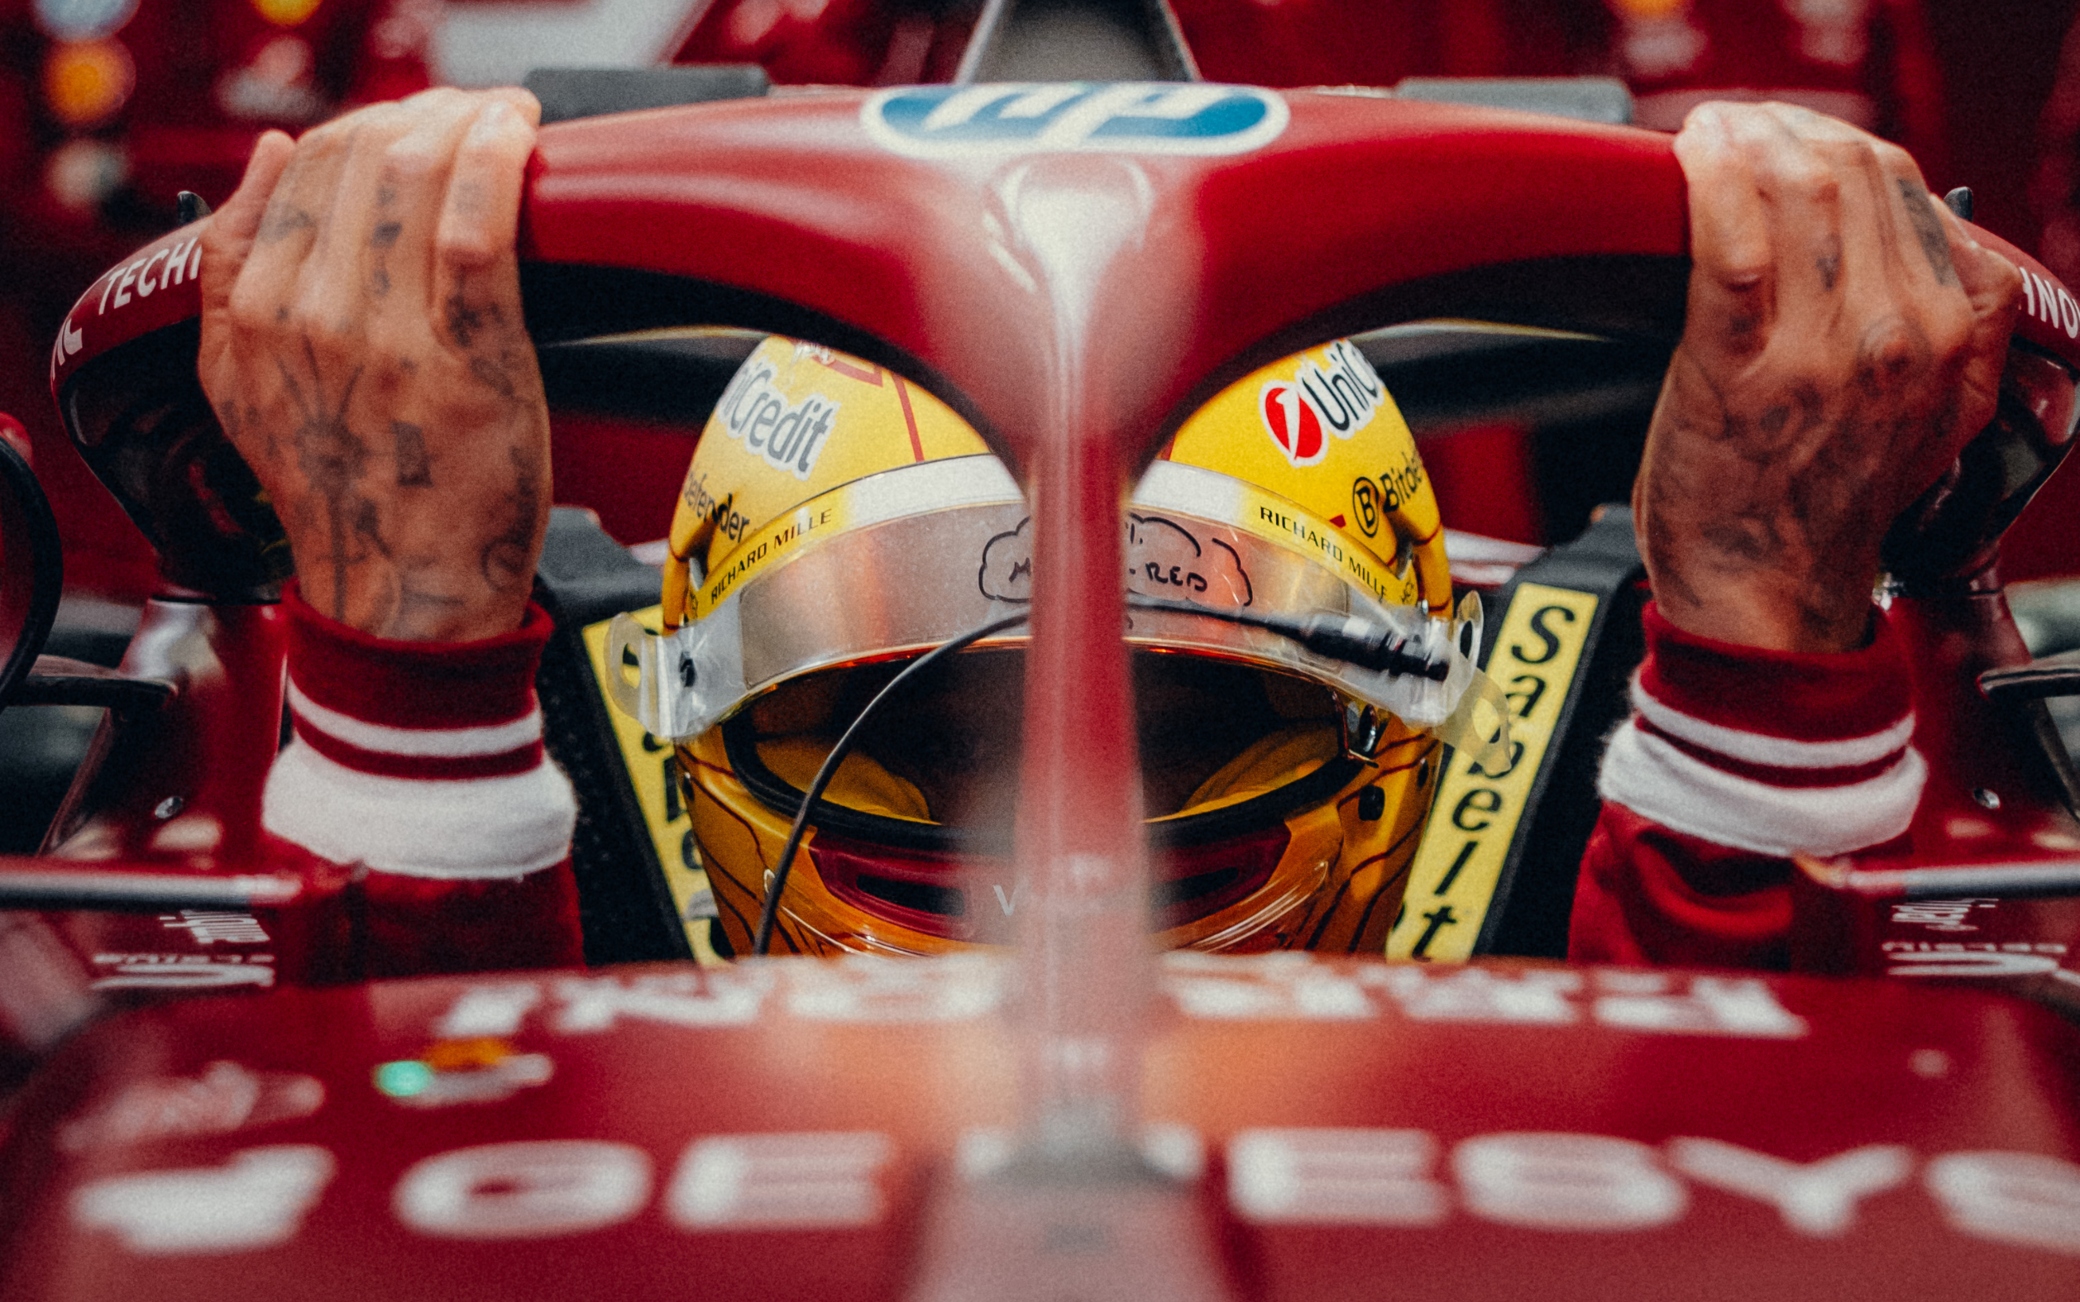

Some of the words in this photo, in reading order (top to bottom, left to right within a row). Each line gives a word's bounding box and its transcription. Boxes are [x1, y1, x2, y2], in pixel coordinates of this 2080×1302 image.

[711, 541, 768, 605] RICHARD
[773, 508, 833, 550] MILLE
[1259, 505, 1343, 563] RICHARD
[1348, 555, 1389, 600] MILLE
